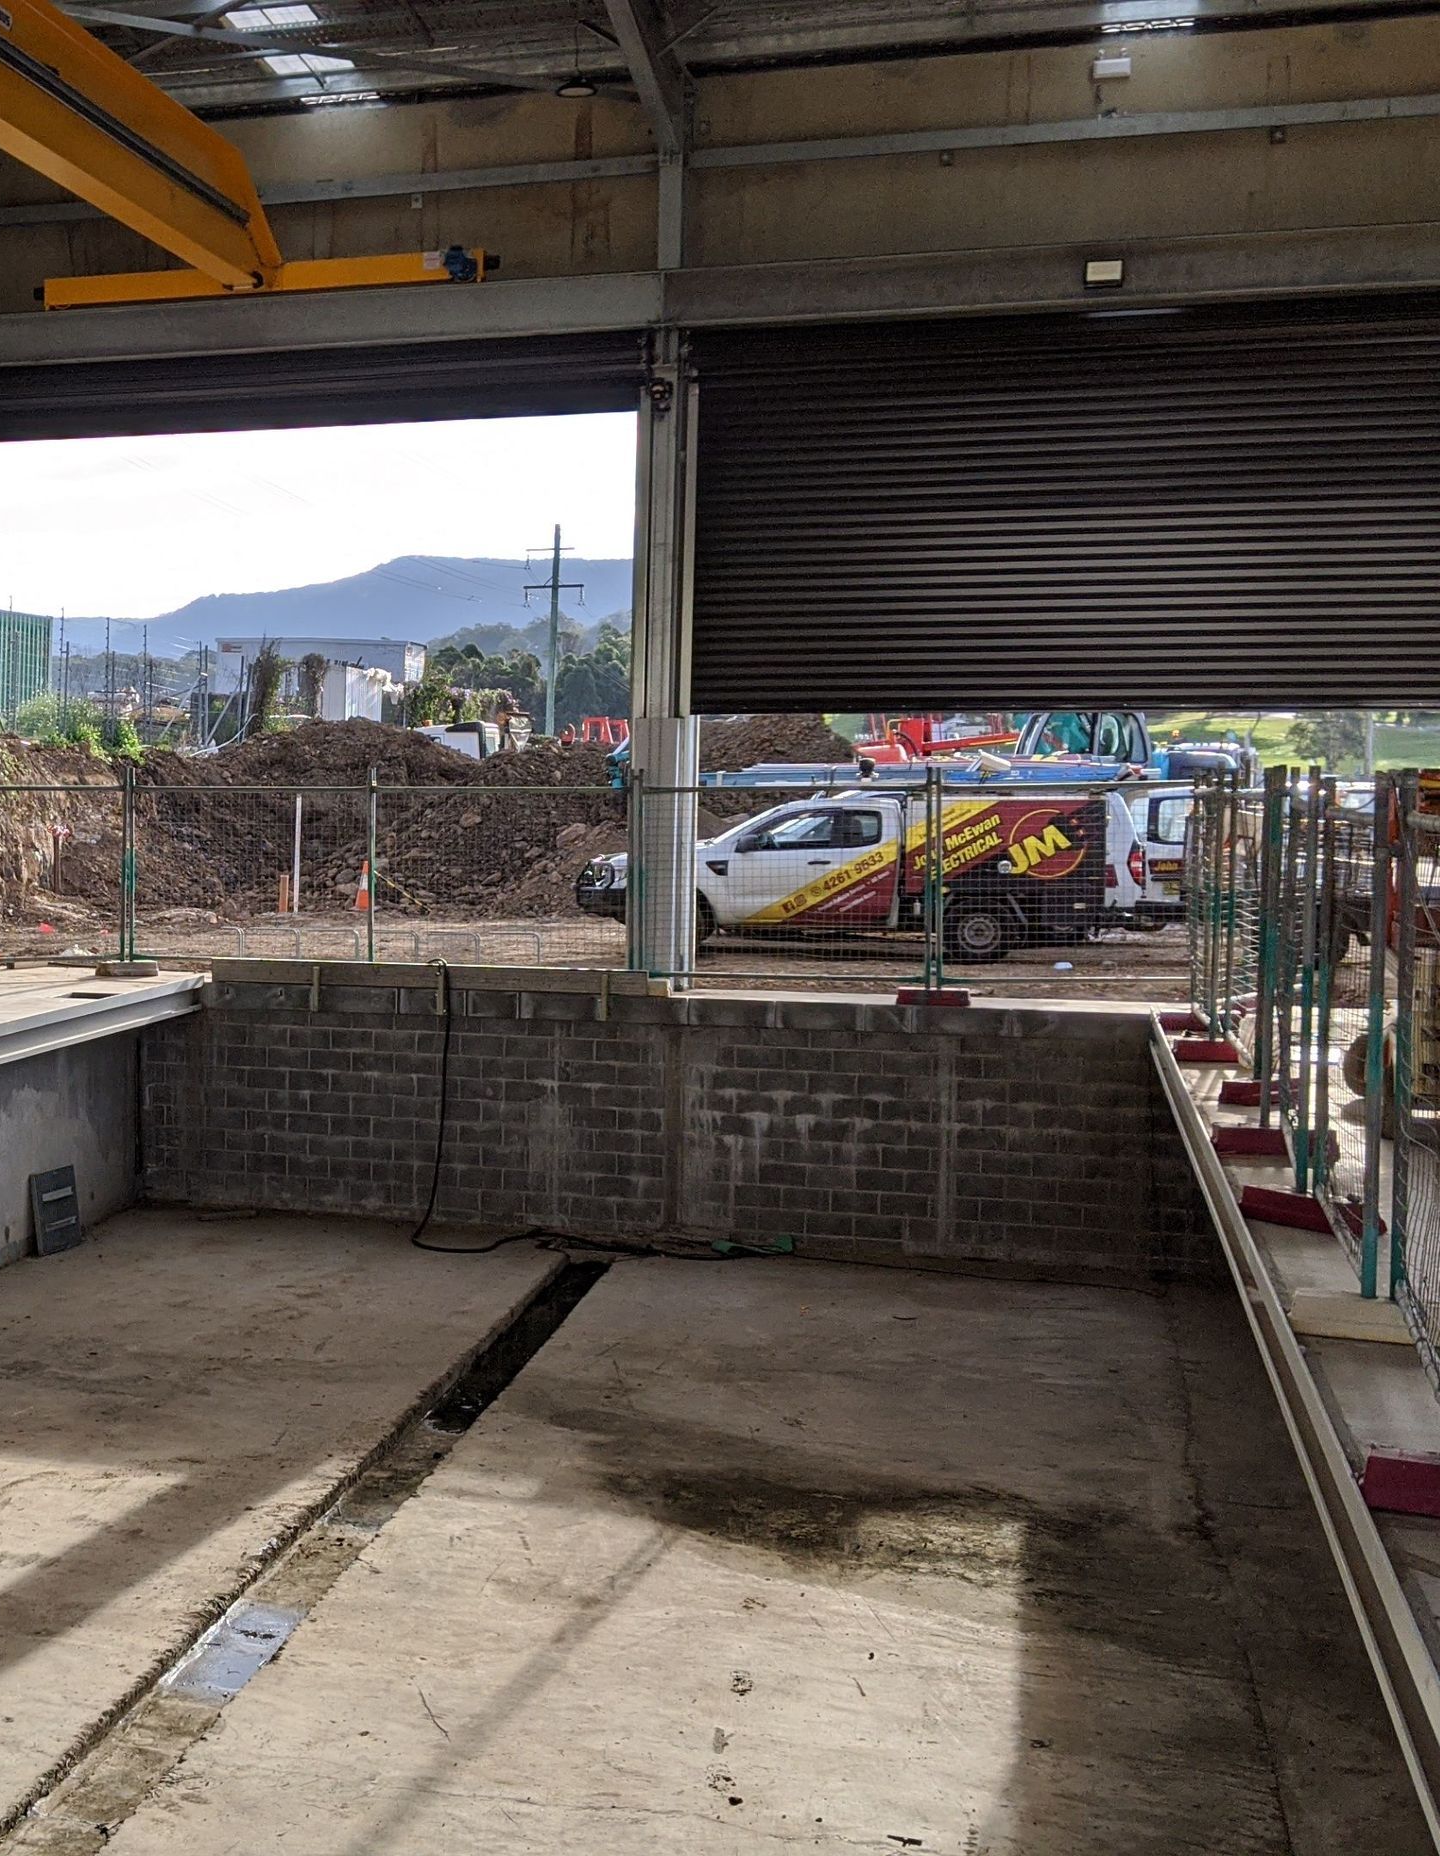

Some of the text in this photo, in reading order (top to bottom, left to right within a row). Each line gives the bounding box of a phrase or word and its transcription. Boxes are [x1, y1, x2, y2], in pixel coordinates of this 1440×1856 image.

[944, 814, 1000, 851] McEwan
[1008, 824, 1072, 875] JM
[931, 831, 1003, 880] EECTRICAL
[823, 869, 851, 890] 4261
